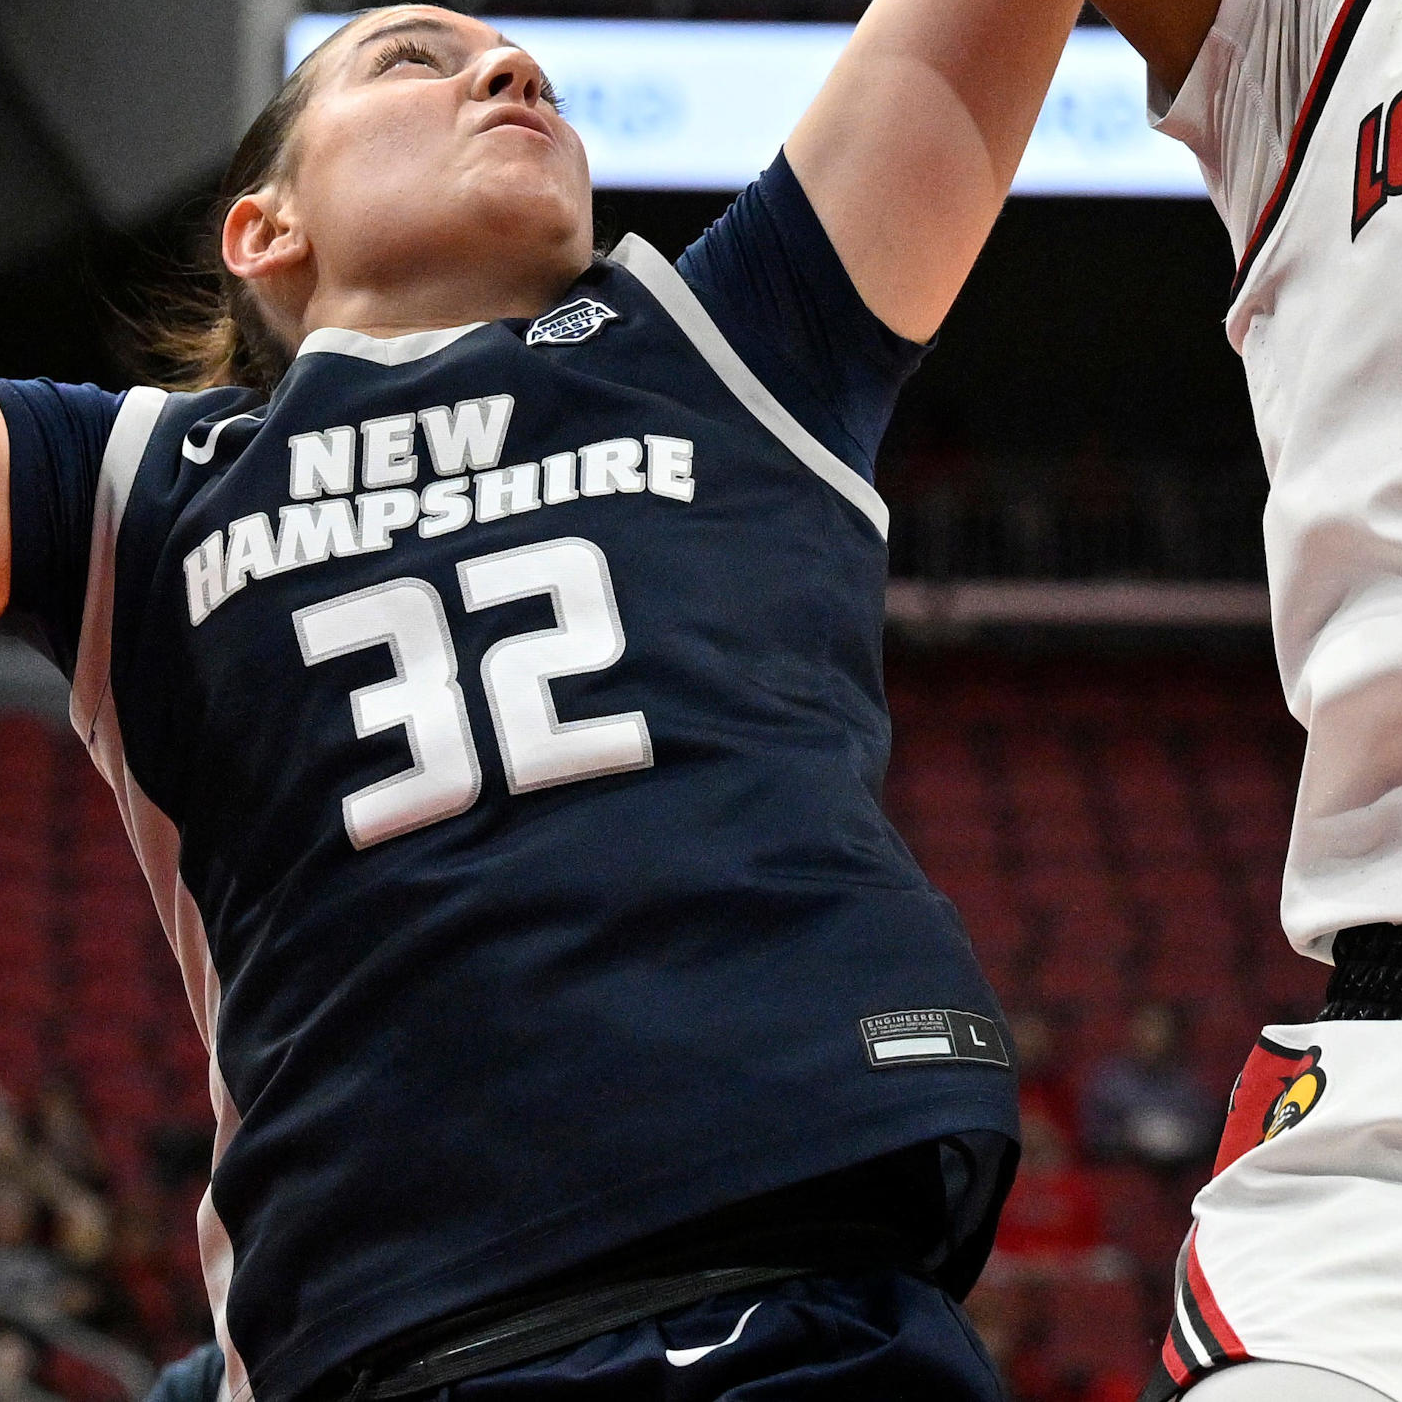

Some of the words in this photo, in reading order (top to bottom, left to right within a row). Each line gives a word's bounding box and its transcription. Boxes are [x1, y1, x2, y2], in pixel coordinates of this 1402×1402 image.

[530, 306, 609, 341] AMERICA
[550, 317, 594, 338] EAST
[288, 394, 516, 500] NEW
[182, 434, 696, 628] HAMPSHIRE
[291, 536, 653, 851] 32
[866, 1013, 944, 1028] ENGINEERED
[968, 1025, 987, 1047] L
